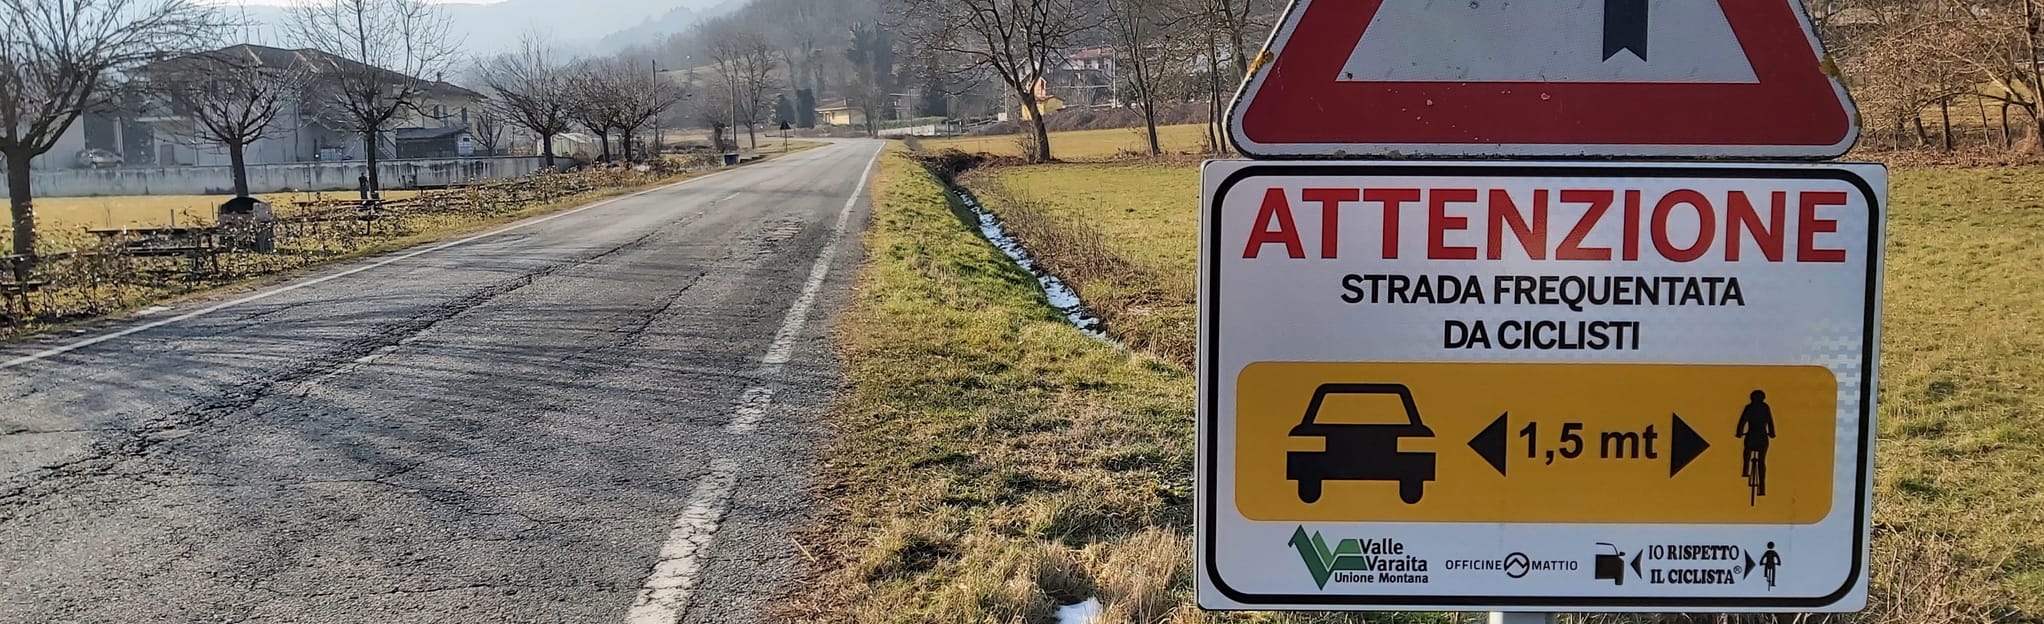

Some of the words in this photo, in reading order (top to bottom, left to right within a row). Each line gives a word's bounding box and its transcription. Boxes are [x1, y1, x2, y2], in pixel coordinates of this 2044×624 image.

[1242, 187, 1848, 263] ATTENZIONE
[1340, 273, 1486, 305] STRADA
[1493, 275, 1745, 312] FREQUENTATA
[1444, 320, 1492, 349] DA
[1498, 320, 1640, 350] CICLISTI
[1519, 421, 1584, 466] 1,5
[1600, 424, 1658, 459] mt
[1359, 538, 1403, 555] Valle
[1649, 544, 1664, 560] IO
[1667, 544, 1740, 560] RISPETTO
[1366, 555, 1428, 572] Varaita
[1445, 559, 1502, 570] OFFICINE
[1531, 560, 1578, 571] MATTIO
[1334, 572, 1374, 583] Unione
[1378, 572, 1429, 584] Montana
[1650, 569, 1665, 584] IL
